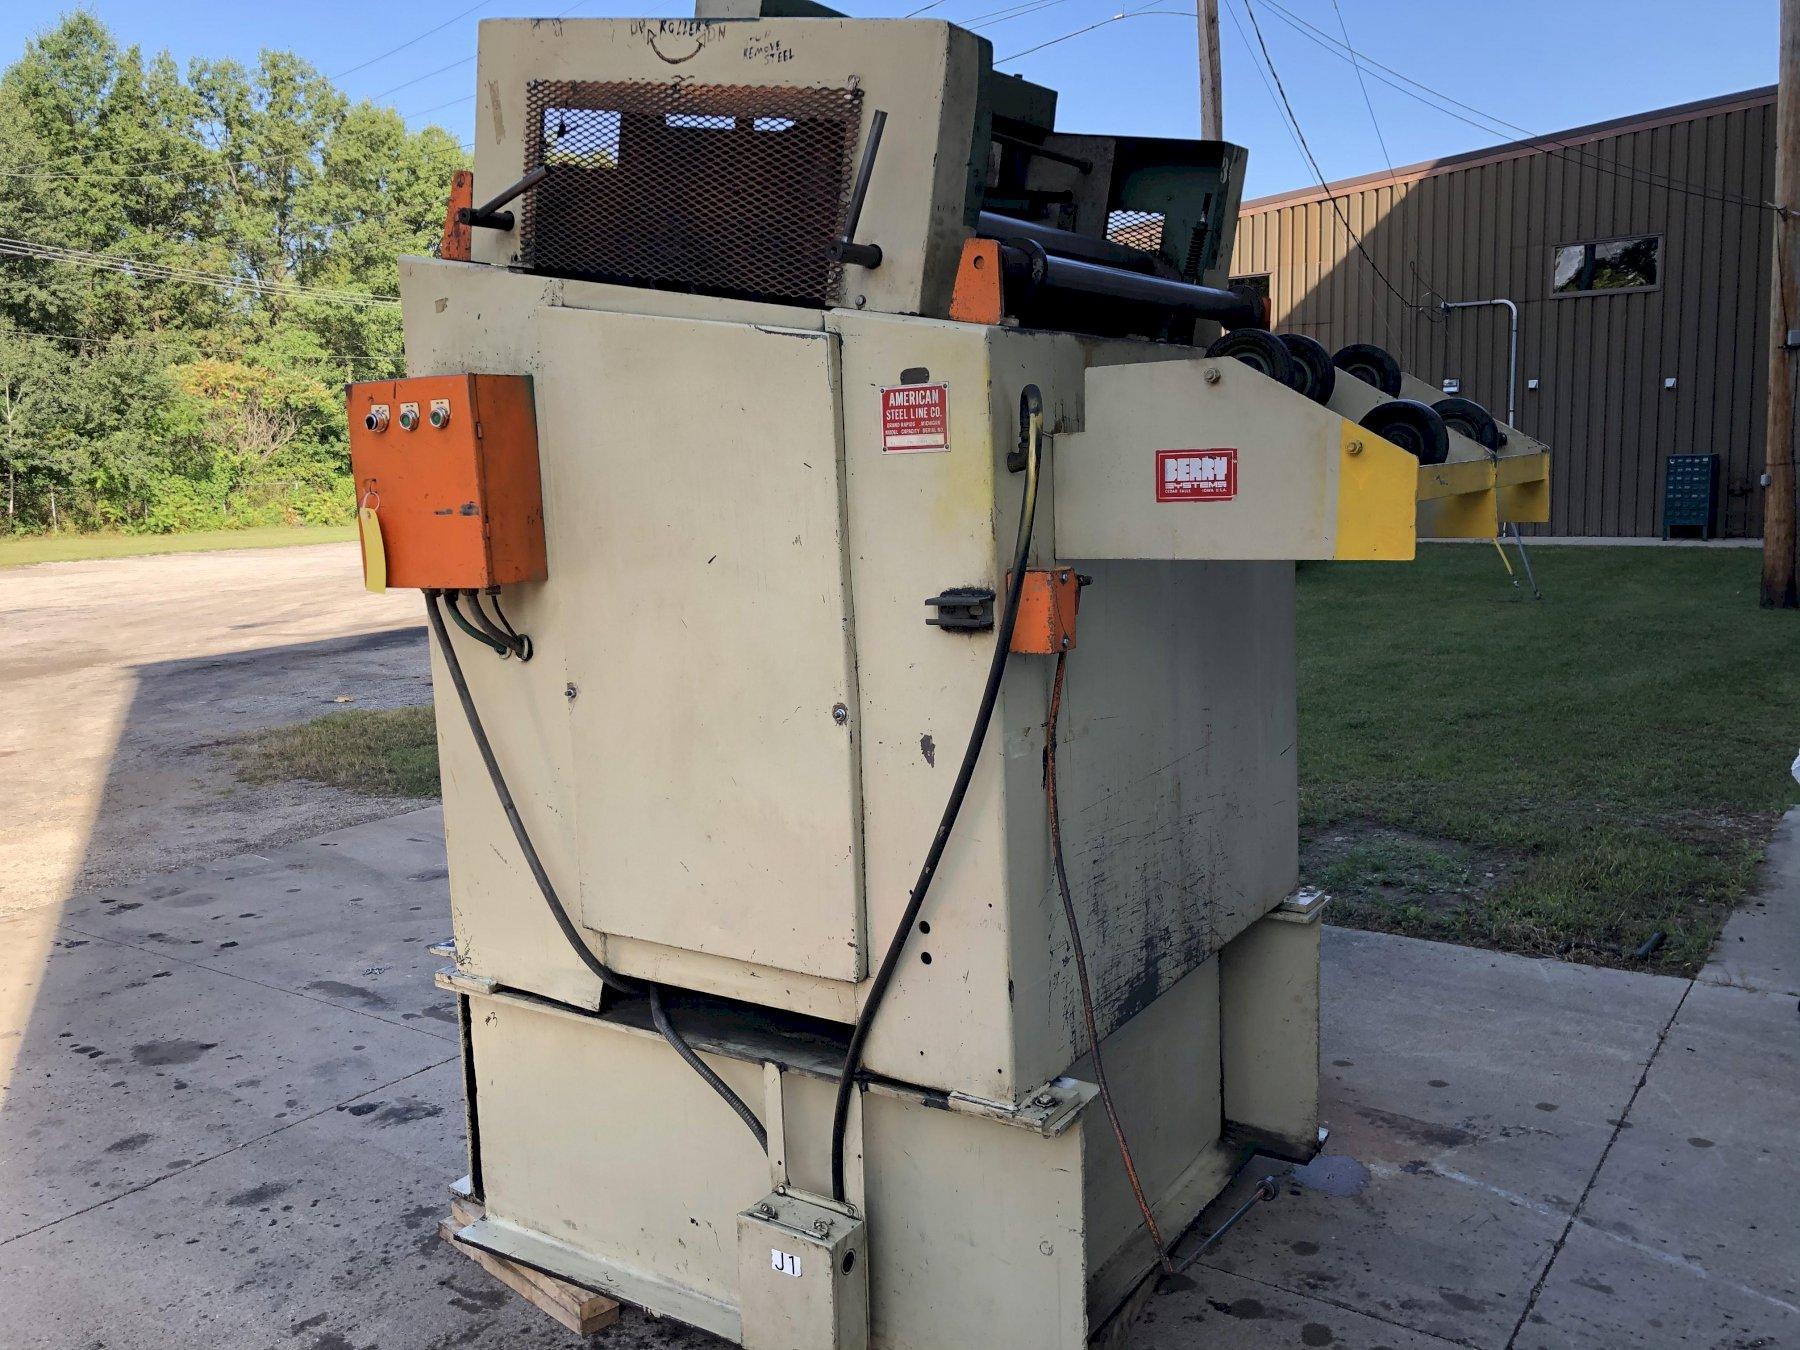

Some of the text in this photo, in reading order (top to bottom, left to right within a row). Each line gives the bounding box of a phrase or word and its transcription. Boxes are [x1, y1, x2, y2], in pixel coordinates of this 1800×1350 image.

[889, 389, 938, 406] AMERICAN
[886, 407, 942, 420] STEEL LINE CO.
[1165, 457, 1227, 481] BERRY
[775, 1252, 795, 1275] J1
